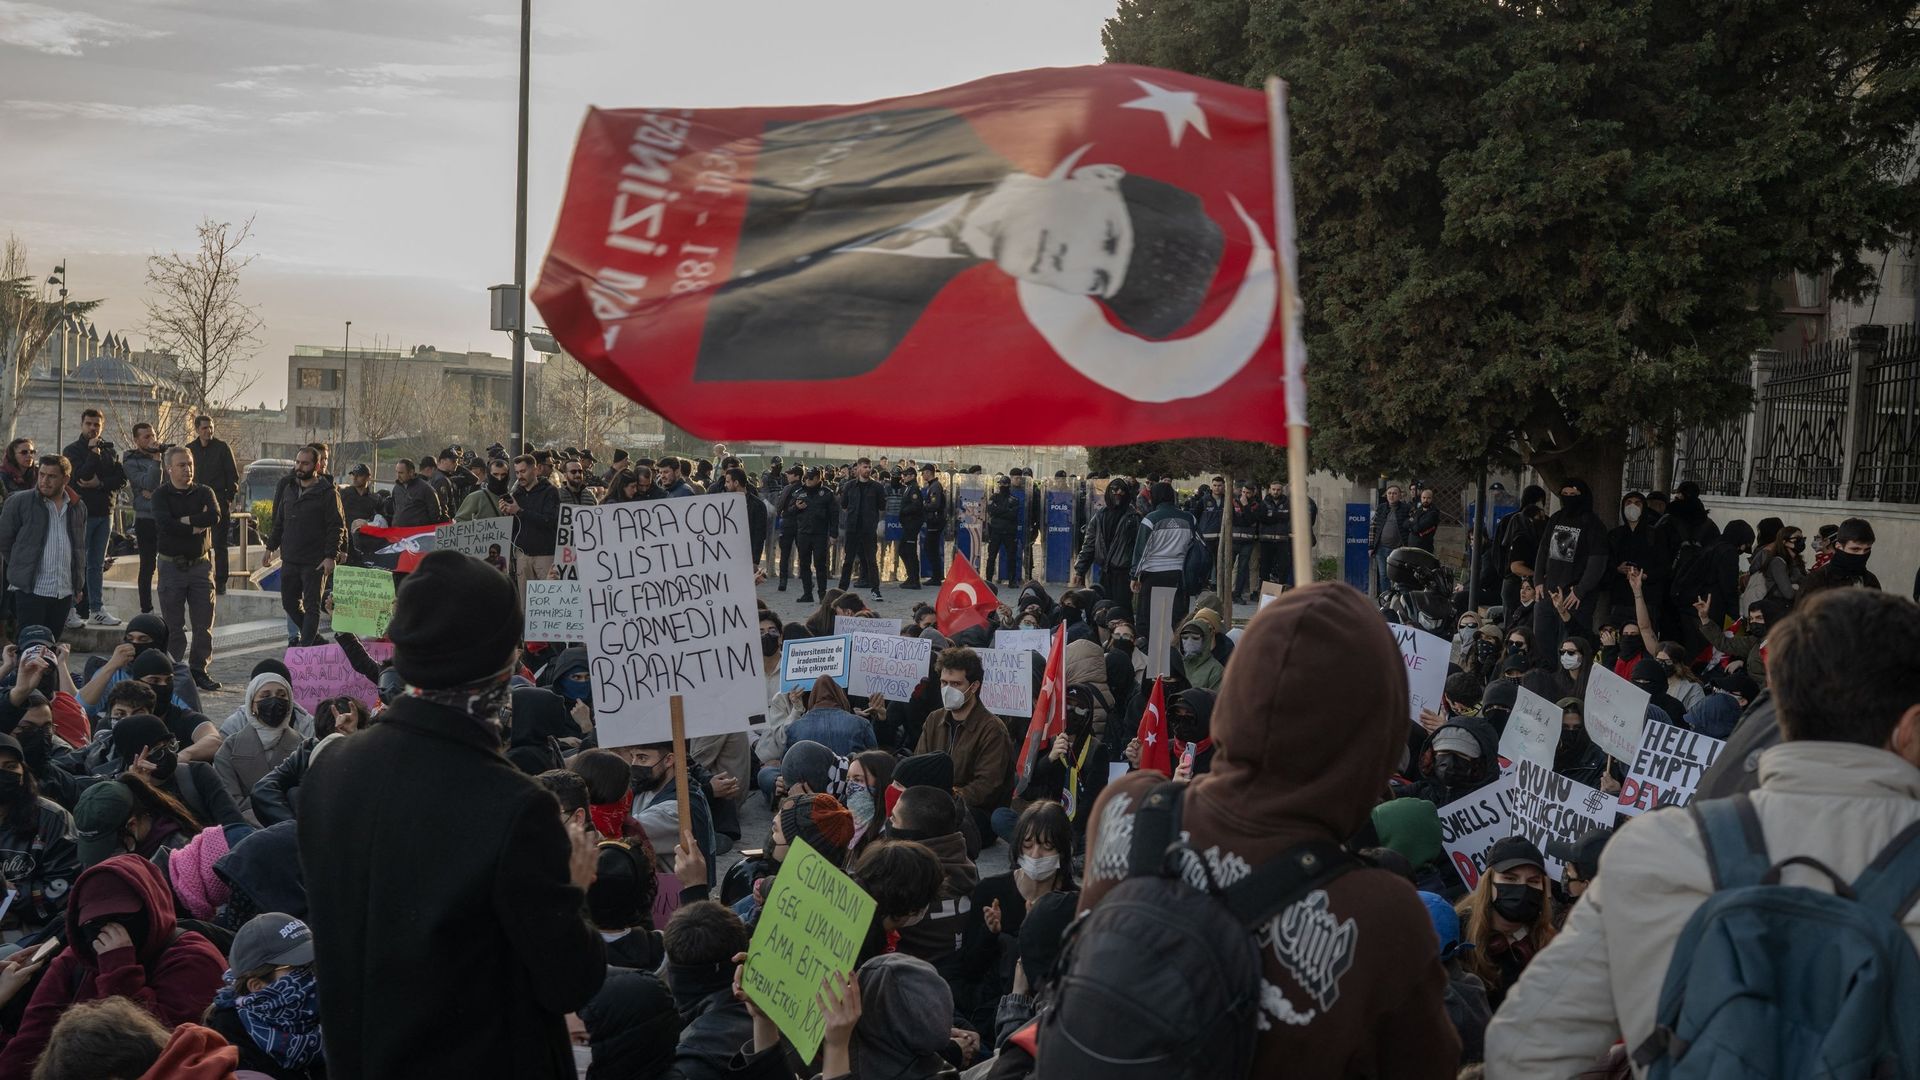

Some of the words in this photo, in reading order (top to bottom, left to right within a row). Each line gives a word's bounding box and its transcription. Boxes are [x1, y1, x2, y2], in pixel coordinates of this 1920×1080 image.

[613, 503, 679, 542] ARA
[685, 499, 739, 542] ÇOK
[597, 539, 731, 583] SUSTUM
[529, 596, 550, 606] FOR
[559, 596, 579, 605] ME
[589, 585, 628, 623] HİÇ
[631, 572, 729, 614] FAYDASINI
[542, 621, 562, 629] THE
[566, 622, 584, 630] BES
[600, 599, 748, 656] GÖRMEDİM
[591, 642, 756, 713] BIRAKTIM
[1643, 721, 1699, 762] HELL
[1518, 759, 1573, 803] OYUNU
[1441, 799, 1501, 844] SMELLS
[797, 853, 864, 923] GÜNAYDIN
[764, 923, 794, 965] AMA
[777, 886, 802, 922] GEÇ
[804, 910, 855, 965] UYANDIN
